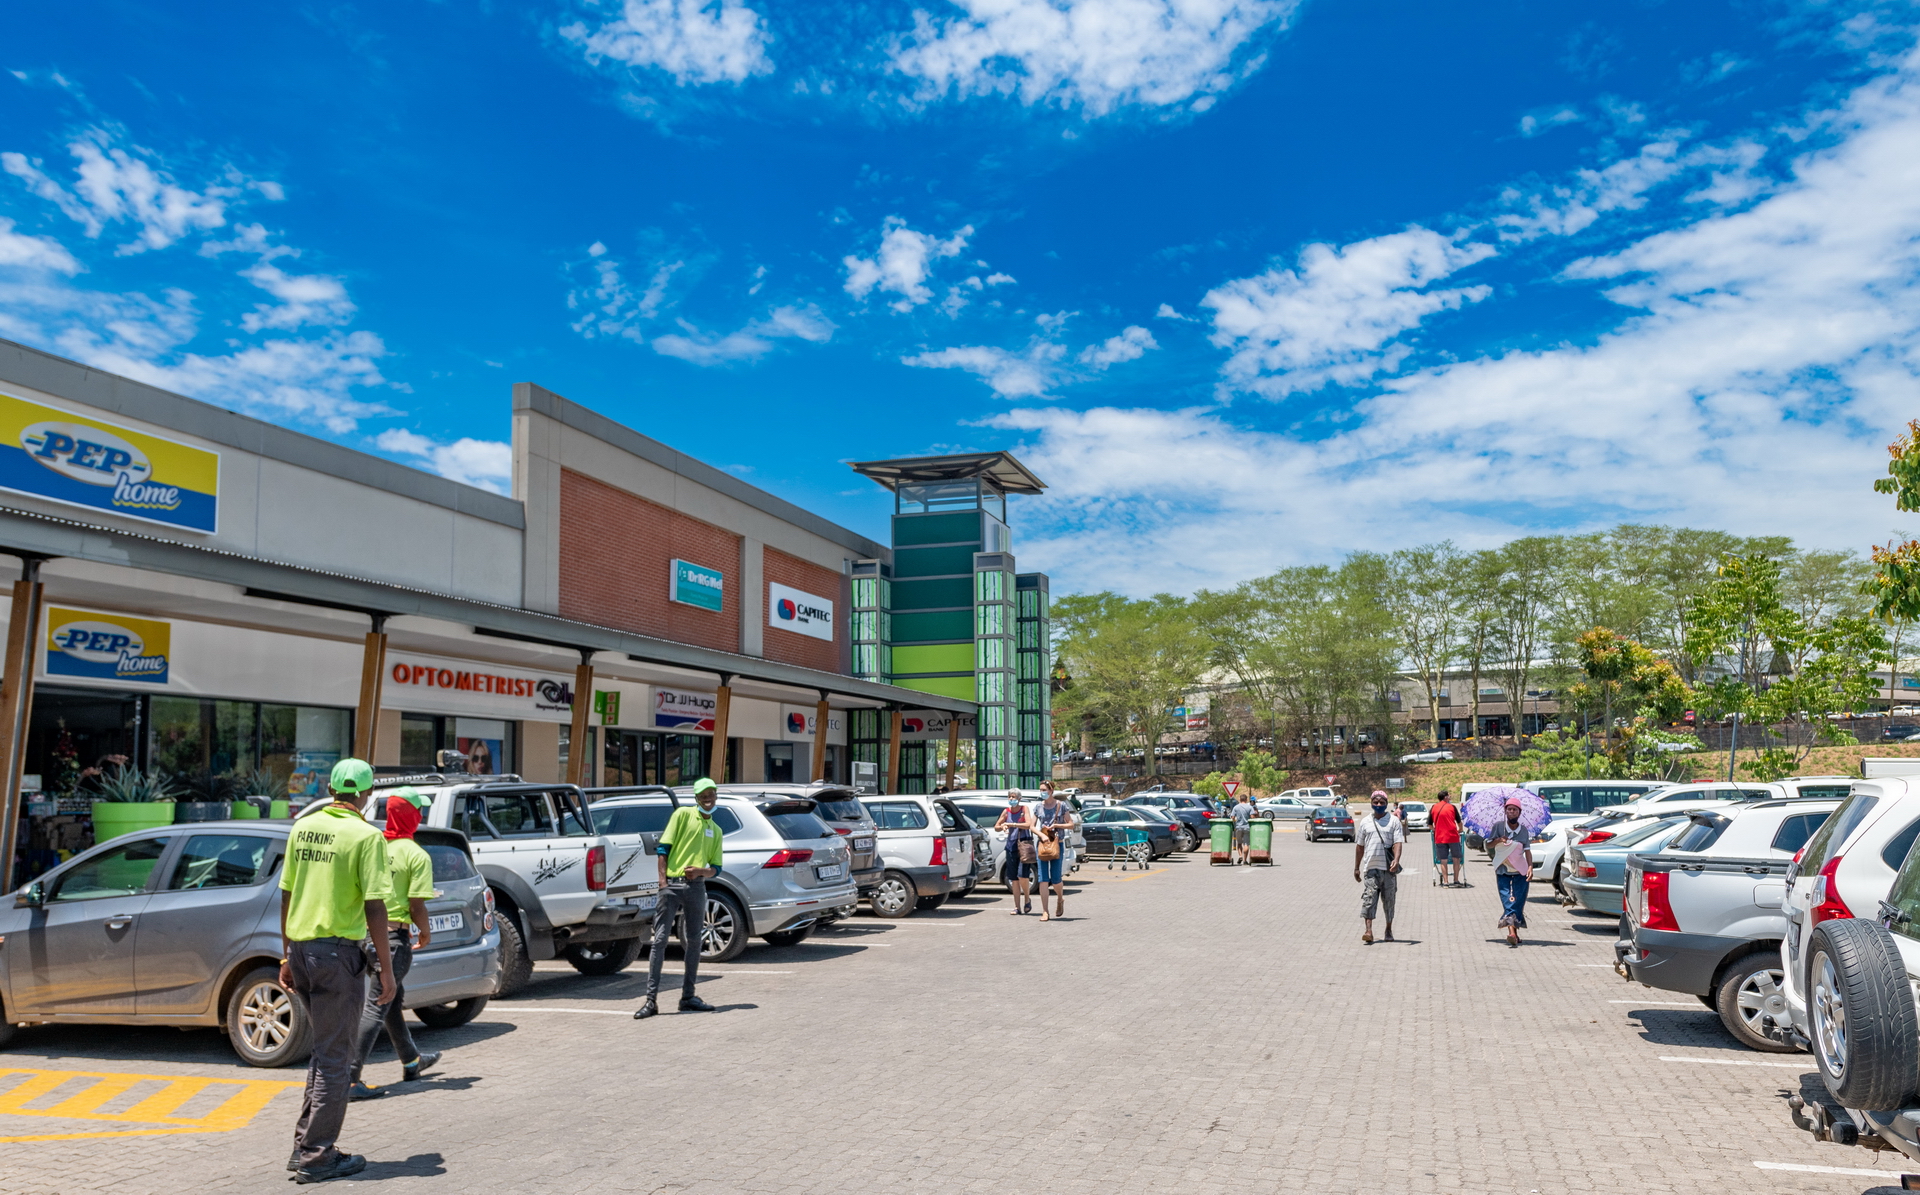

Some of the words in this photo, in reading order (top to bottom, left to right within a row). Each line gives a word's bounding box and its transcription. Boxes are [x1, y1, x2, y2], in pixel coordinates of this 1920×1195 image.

[34, 430, 132, 475] PEP
[114, 472, 180, 505] home
[797, 604, 831, 623] CAPITEC
[62, 629, 130, 653] PEP
[117, 650, 165, 672] home
[392, 663, 536, 697] OPTOMETRIST
[665, 692, 677, 704] Dr
[688, 695, 715, 709] Hugo
[808, 716, 840, 730] CTEC
[927, 717, 976, 727] CAPTEC
[373, 775, 427, 784] ARDBODY
[297, 831, 335, 845] PARKING
[450, 915, 460, 928] GP
